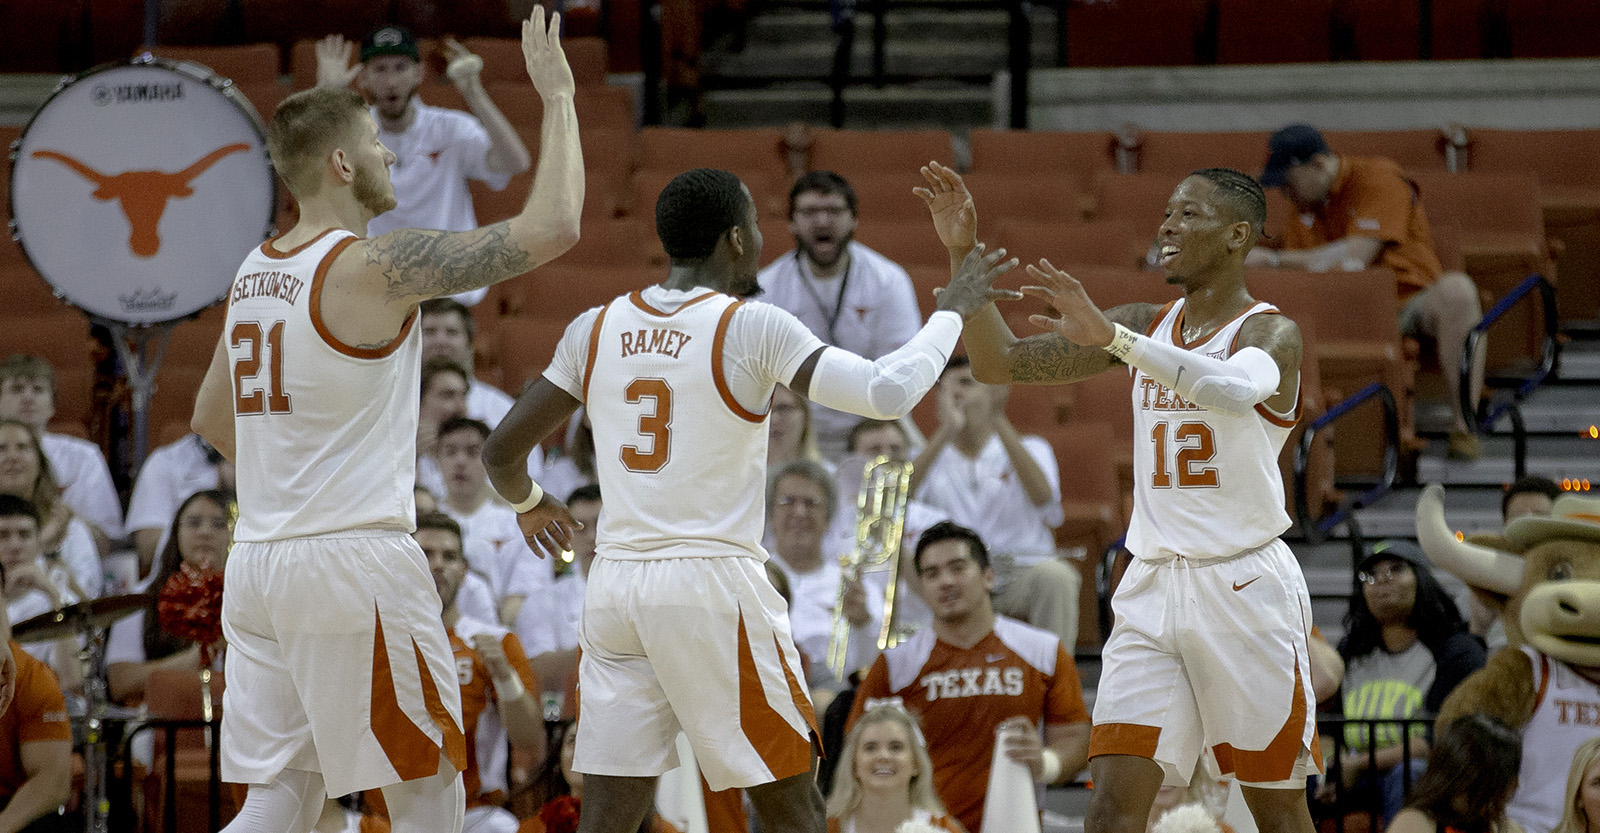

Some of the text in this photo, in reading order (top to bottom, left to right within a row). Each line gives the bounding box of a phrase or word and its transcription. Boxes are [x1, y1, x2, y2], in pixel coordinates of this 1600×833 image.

[231, 319, 293, 417] 21
[620, 329, 692, 359] RAMEY
[619, 376, 674, 474] 3
[1150, 420, 1221, 490] 12
[920, 665, 1025, 702] TEXAS
